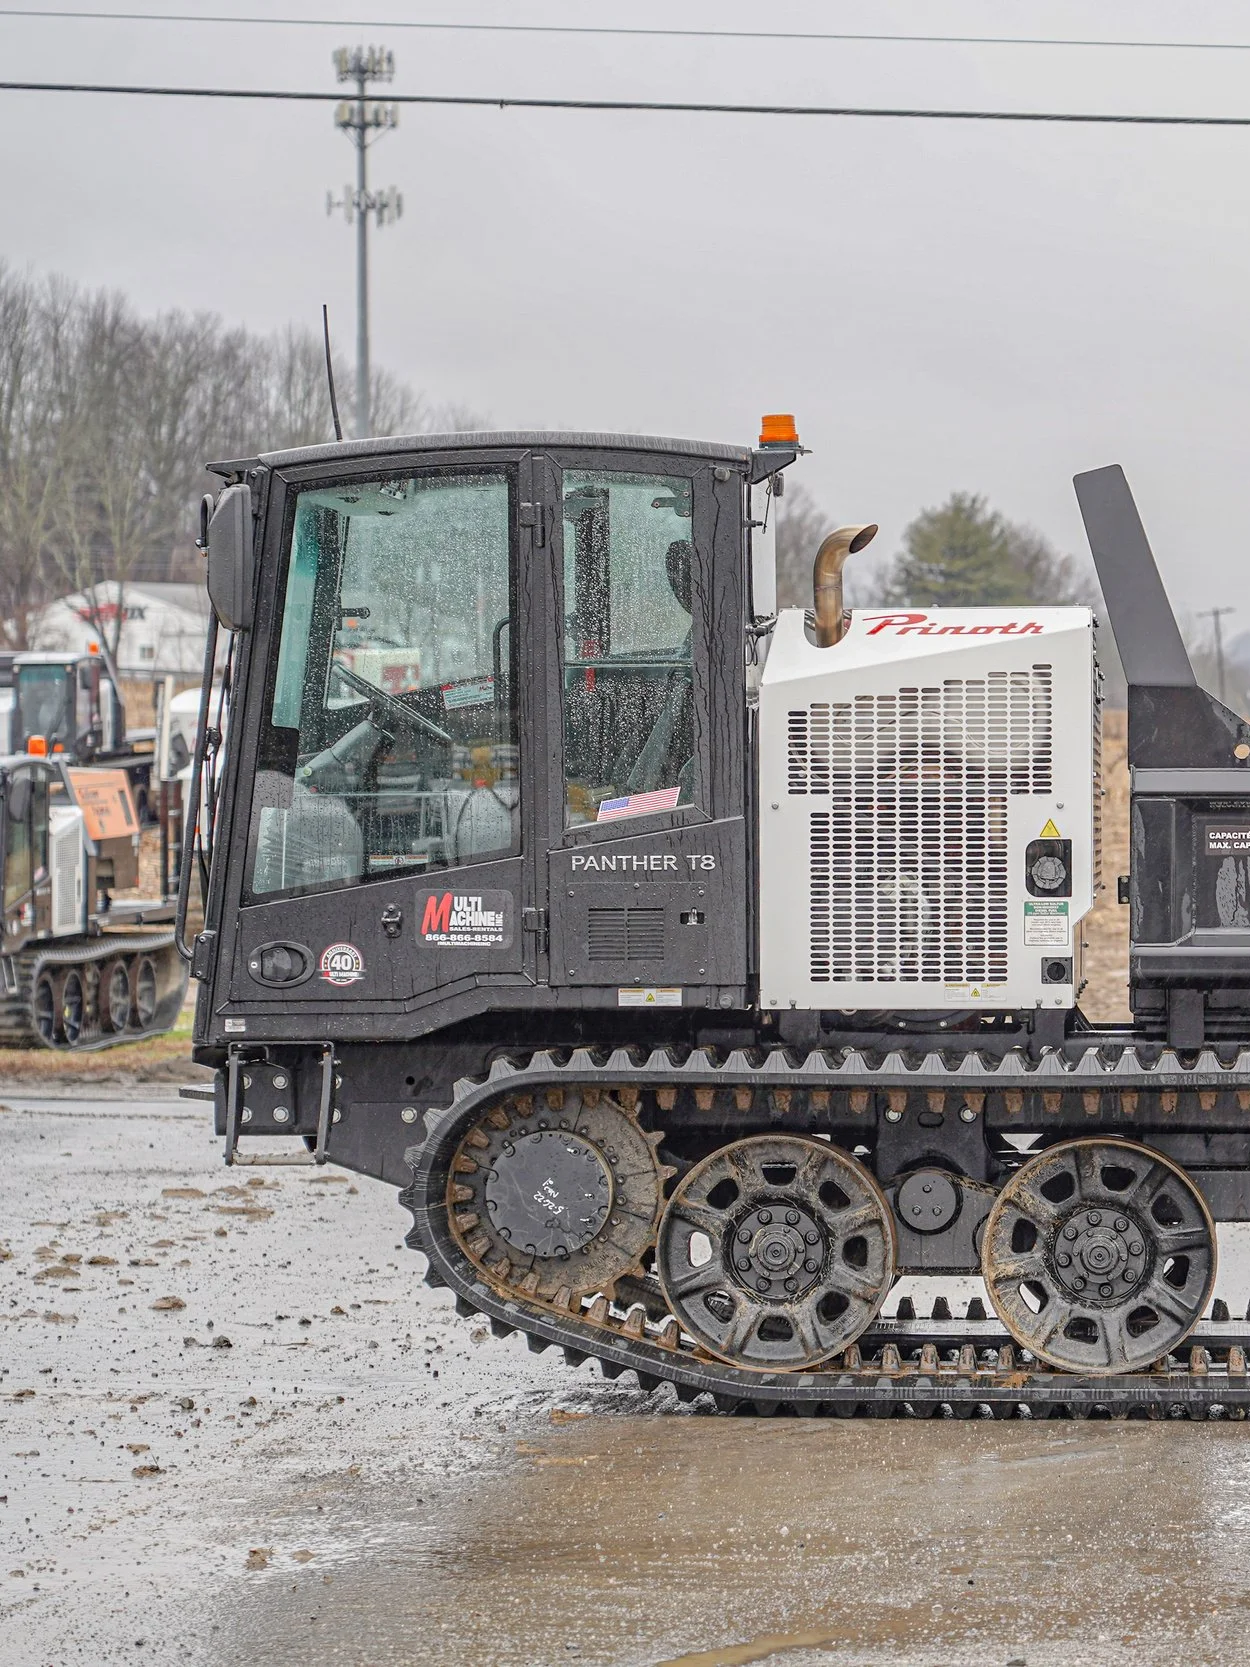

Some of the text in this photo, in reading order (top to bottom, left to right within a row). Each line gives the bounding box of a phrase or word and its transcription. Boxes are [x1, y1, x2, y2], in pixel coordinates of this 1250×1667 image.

[862, 614, 1044, 635] Prinoth
[571, 854, 716, 871] PANTHER T8
[425, 933, 503, 942] 866-866-8584
[330, 954, 353, 971] 40
